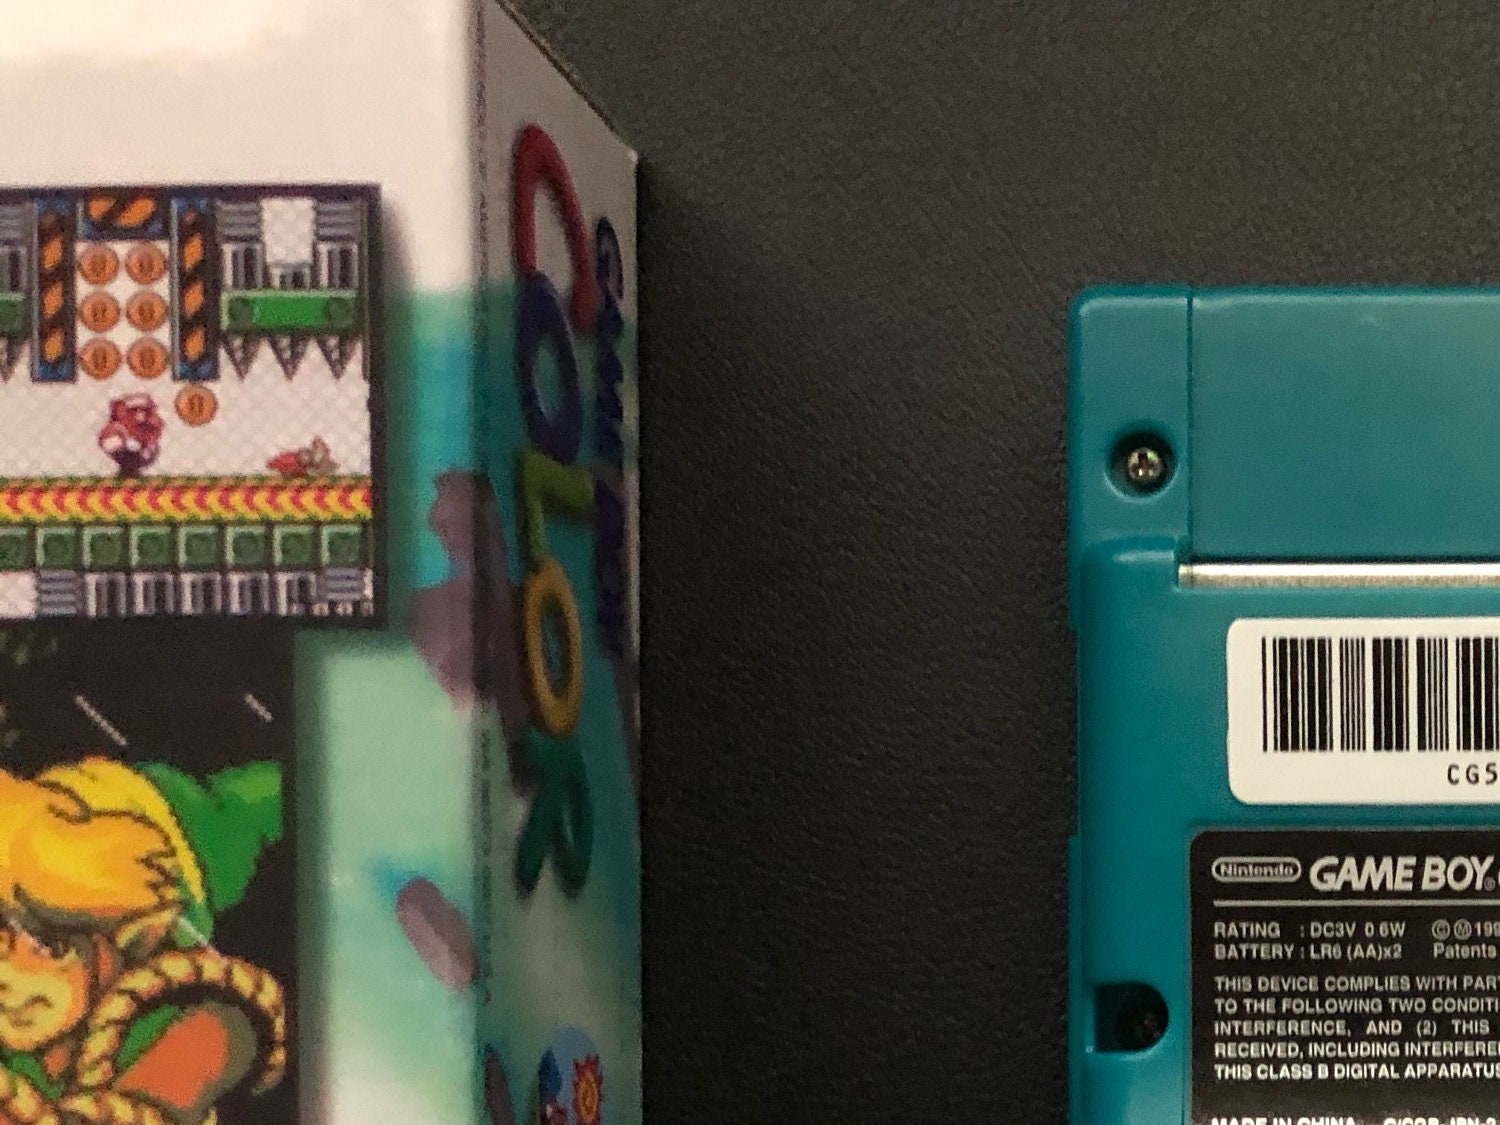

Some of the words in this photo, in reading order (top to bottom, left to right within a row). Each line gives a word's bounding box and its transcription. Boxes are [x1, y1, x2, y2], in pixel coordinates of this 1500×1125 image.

[513, 123, 597, 899] COLOR
[1220, 863, 1293, 877] Nintendo
[1309, 856, 1417, 892] GAME
[1214, 921, 1280, 938] RATING
[1310, 921, 1357, 938] DC3V
[1214, 944, 1294, 960] BATTERY
[1310, 943, 1342, 960] LR6
[1433, 942, 1497, 959] Patents
[1214, 976, 1252, 992] THIS
[1257, 976, 1319, 992] DEVICE
[1324, 976, 1411, 992] COMPLIES
[1416, 975, 1458, 991] WITH
[1214, 998, 1237, 1014] TO
[1243, 998, 1276, 1014] THE
[1281, 998, 1383, 1014] FOLLOWING
[1389, 998, 1426, 1014] TWO
[1214, 1020, 1351, 1037] INTERFERENCE,
[1366, 1020, 1402, 1037] AND
[1416, 1020, 1437, 1037] (2)
[1451, 1019, 1490, 1035] THIS
[1214, 1043, 1303, 1059] RECEIVED,
[1308, 1043, 1400, 1059] INCLUDING
[1214, 1064, 1252, 1080] THIS
[1257, 1064, 1313, 1080] CLASS
[1318, 1064, 1329, 1080] B
[1333, 1064, 1400, 1080] DIGITAL
